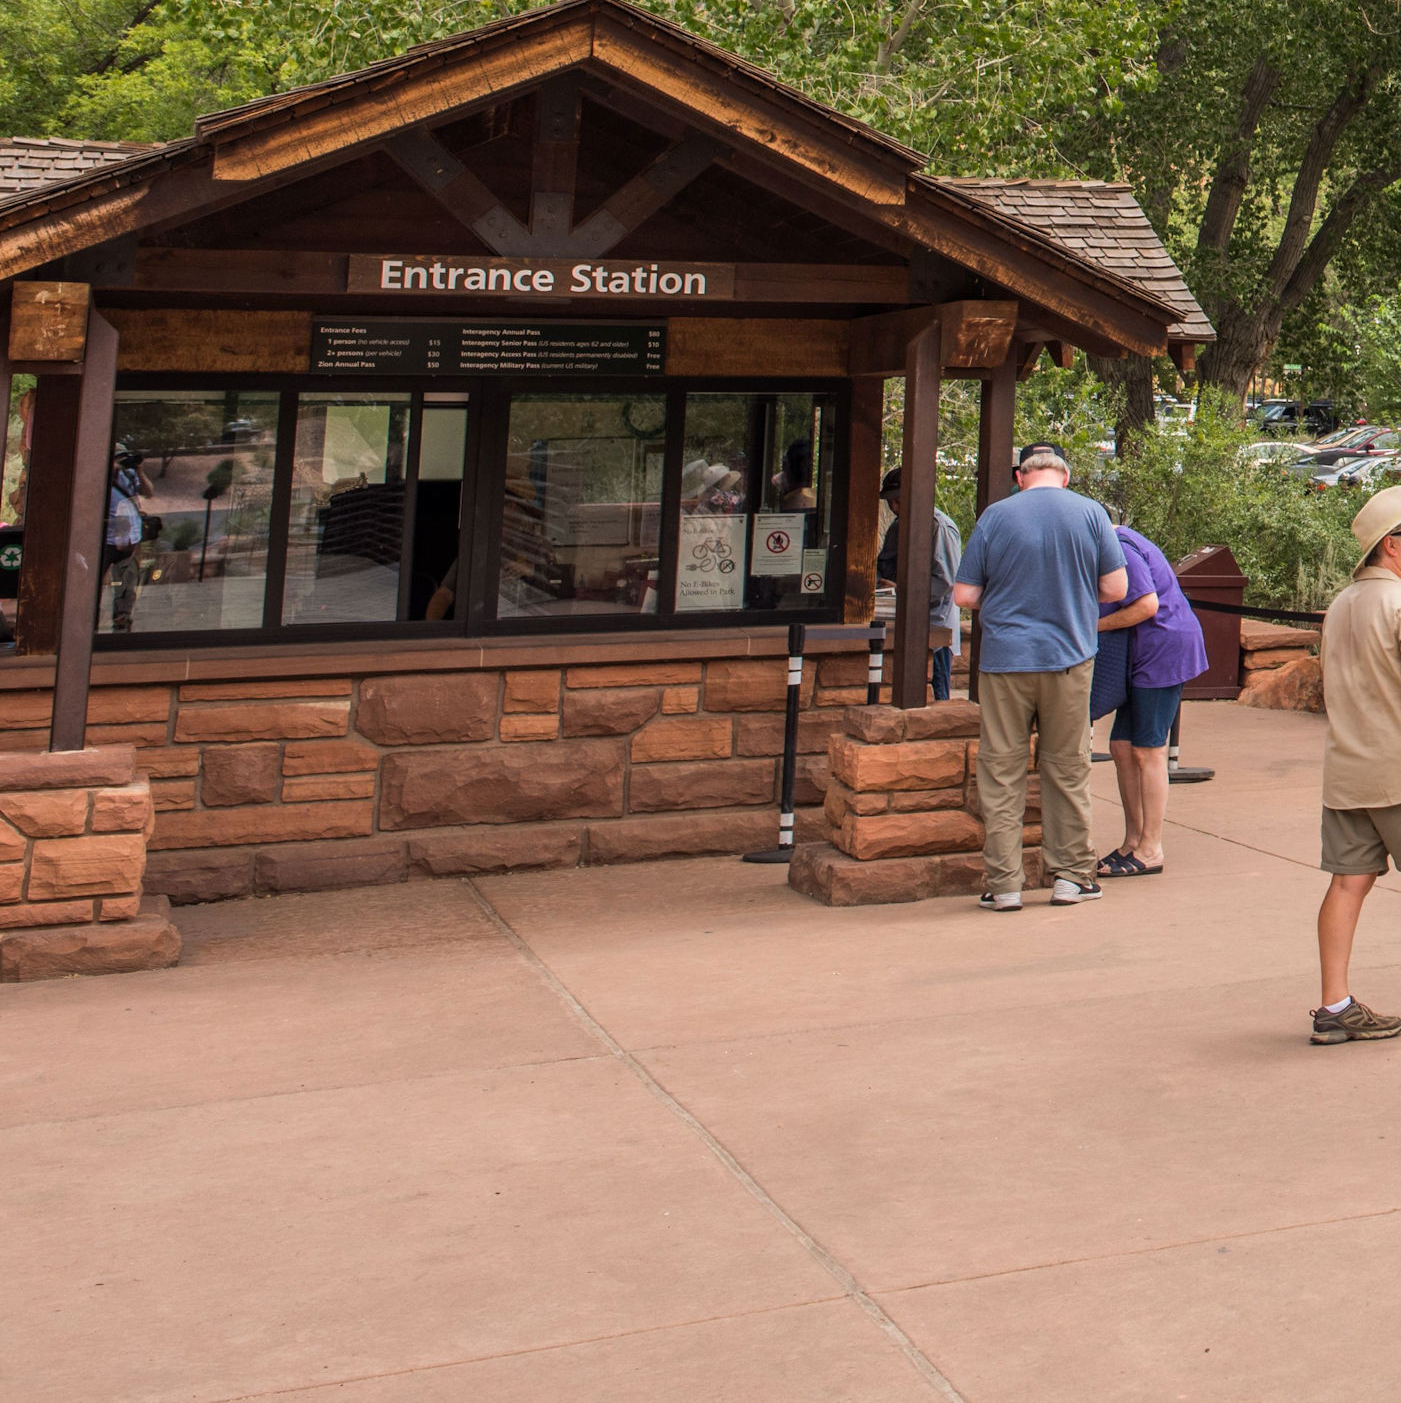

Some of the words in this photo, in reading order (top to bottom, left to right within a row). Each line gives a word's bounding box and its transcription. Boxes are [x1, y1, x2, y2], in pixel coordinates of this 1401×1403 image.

[380, 260, 555, 292] Entrance
[570, 263, 707, 295] Station
[680, 588, 709, 596] Allowed
[719, 588, 736, 596] Park
